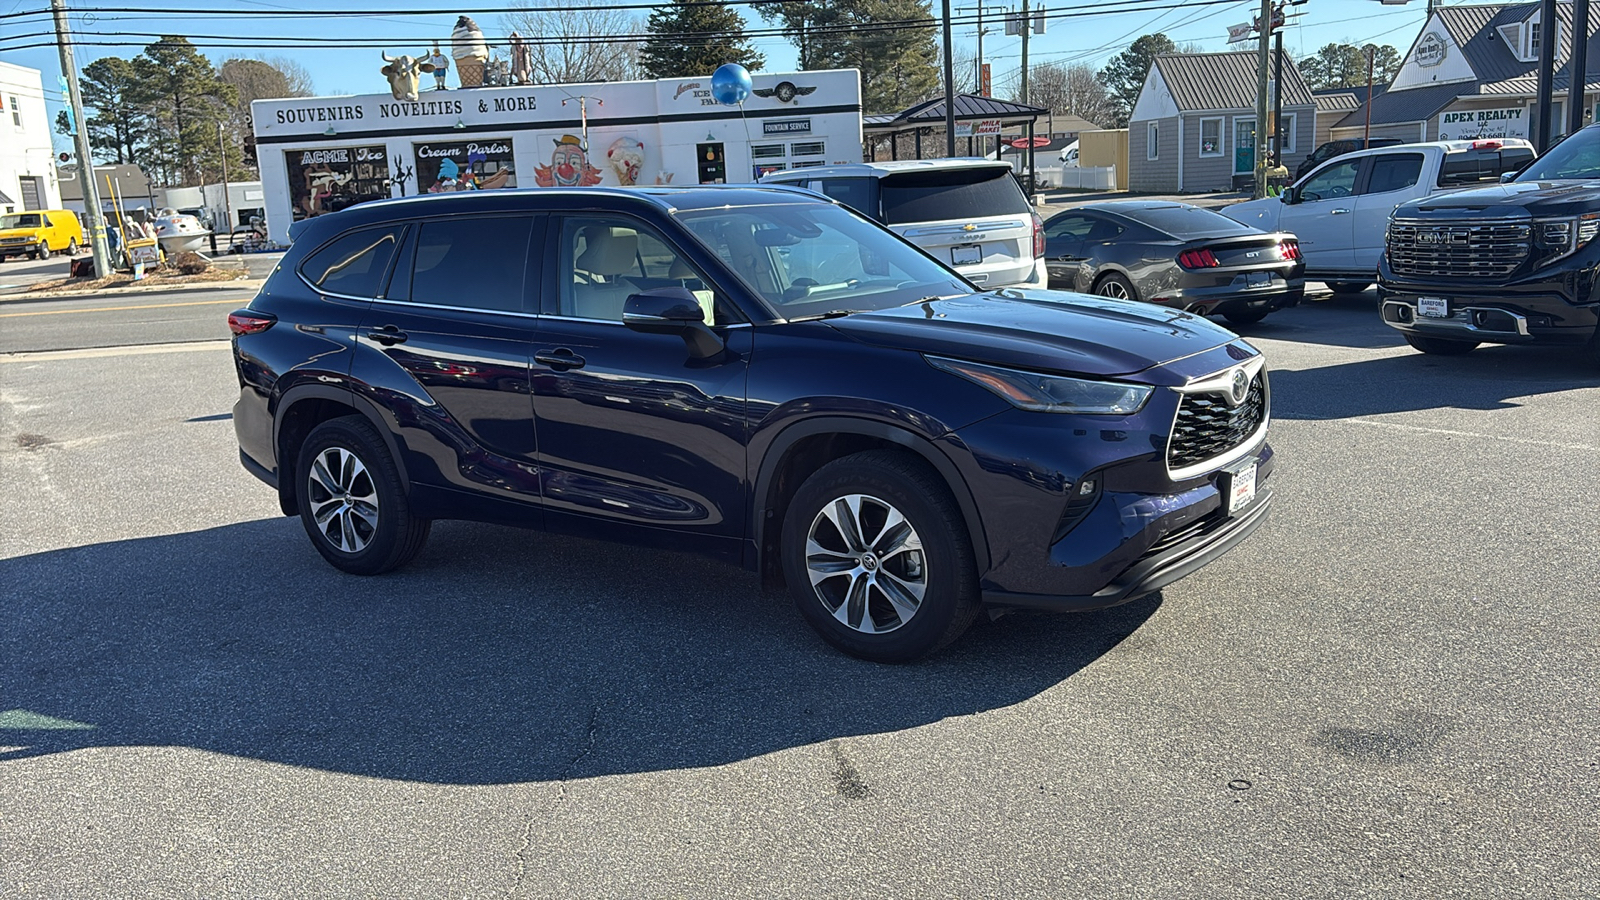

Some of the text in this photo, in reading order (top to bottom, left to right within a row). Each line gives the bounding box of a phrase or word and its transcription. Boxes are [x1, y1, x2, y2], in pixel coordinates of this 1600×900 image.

[693, 90, 711, 98] ICE
[276, 96, 537, 124] SOUVENIRS NOVELTIES & MORE
[1444, 109, 1522, 123] APEX REALTY
[764, 121, 809, 132] FOUNTAIN SERVICE
[301, 148, 385, 165] ACME Ice
[418, 142, 511, 158] Cream Parlor
[1417, 231, 1468, 244] GMC
